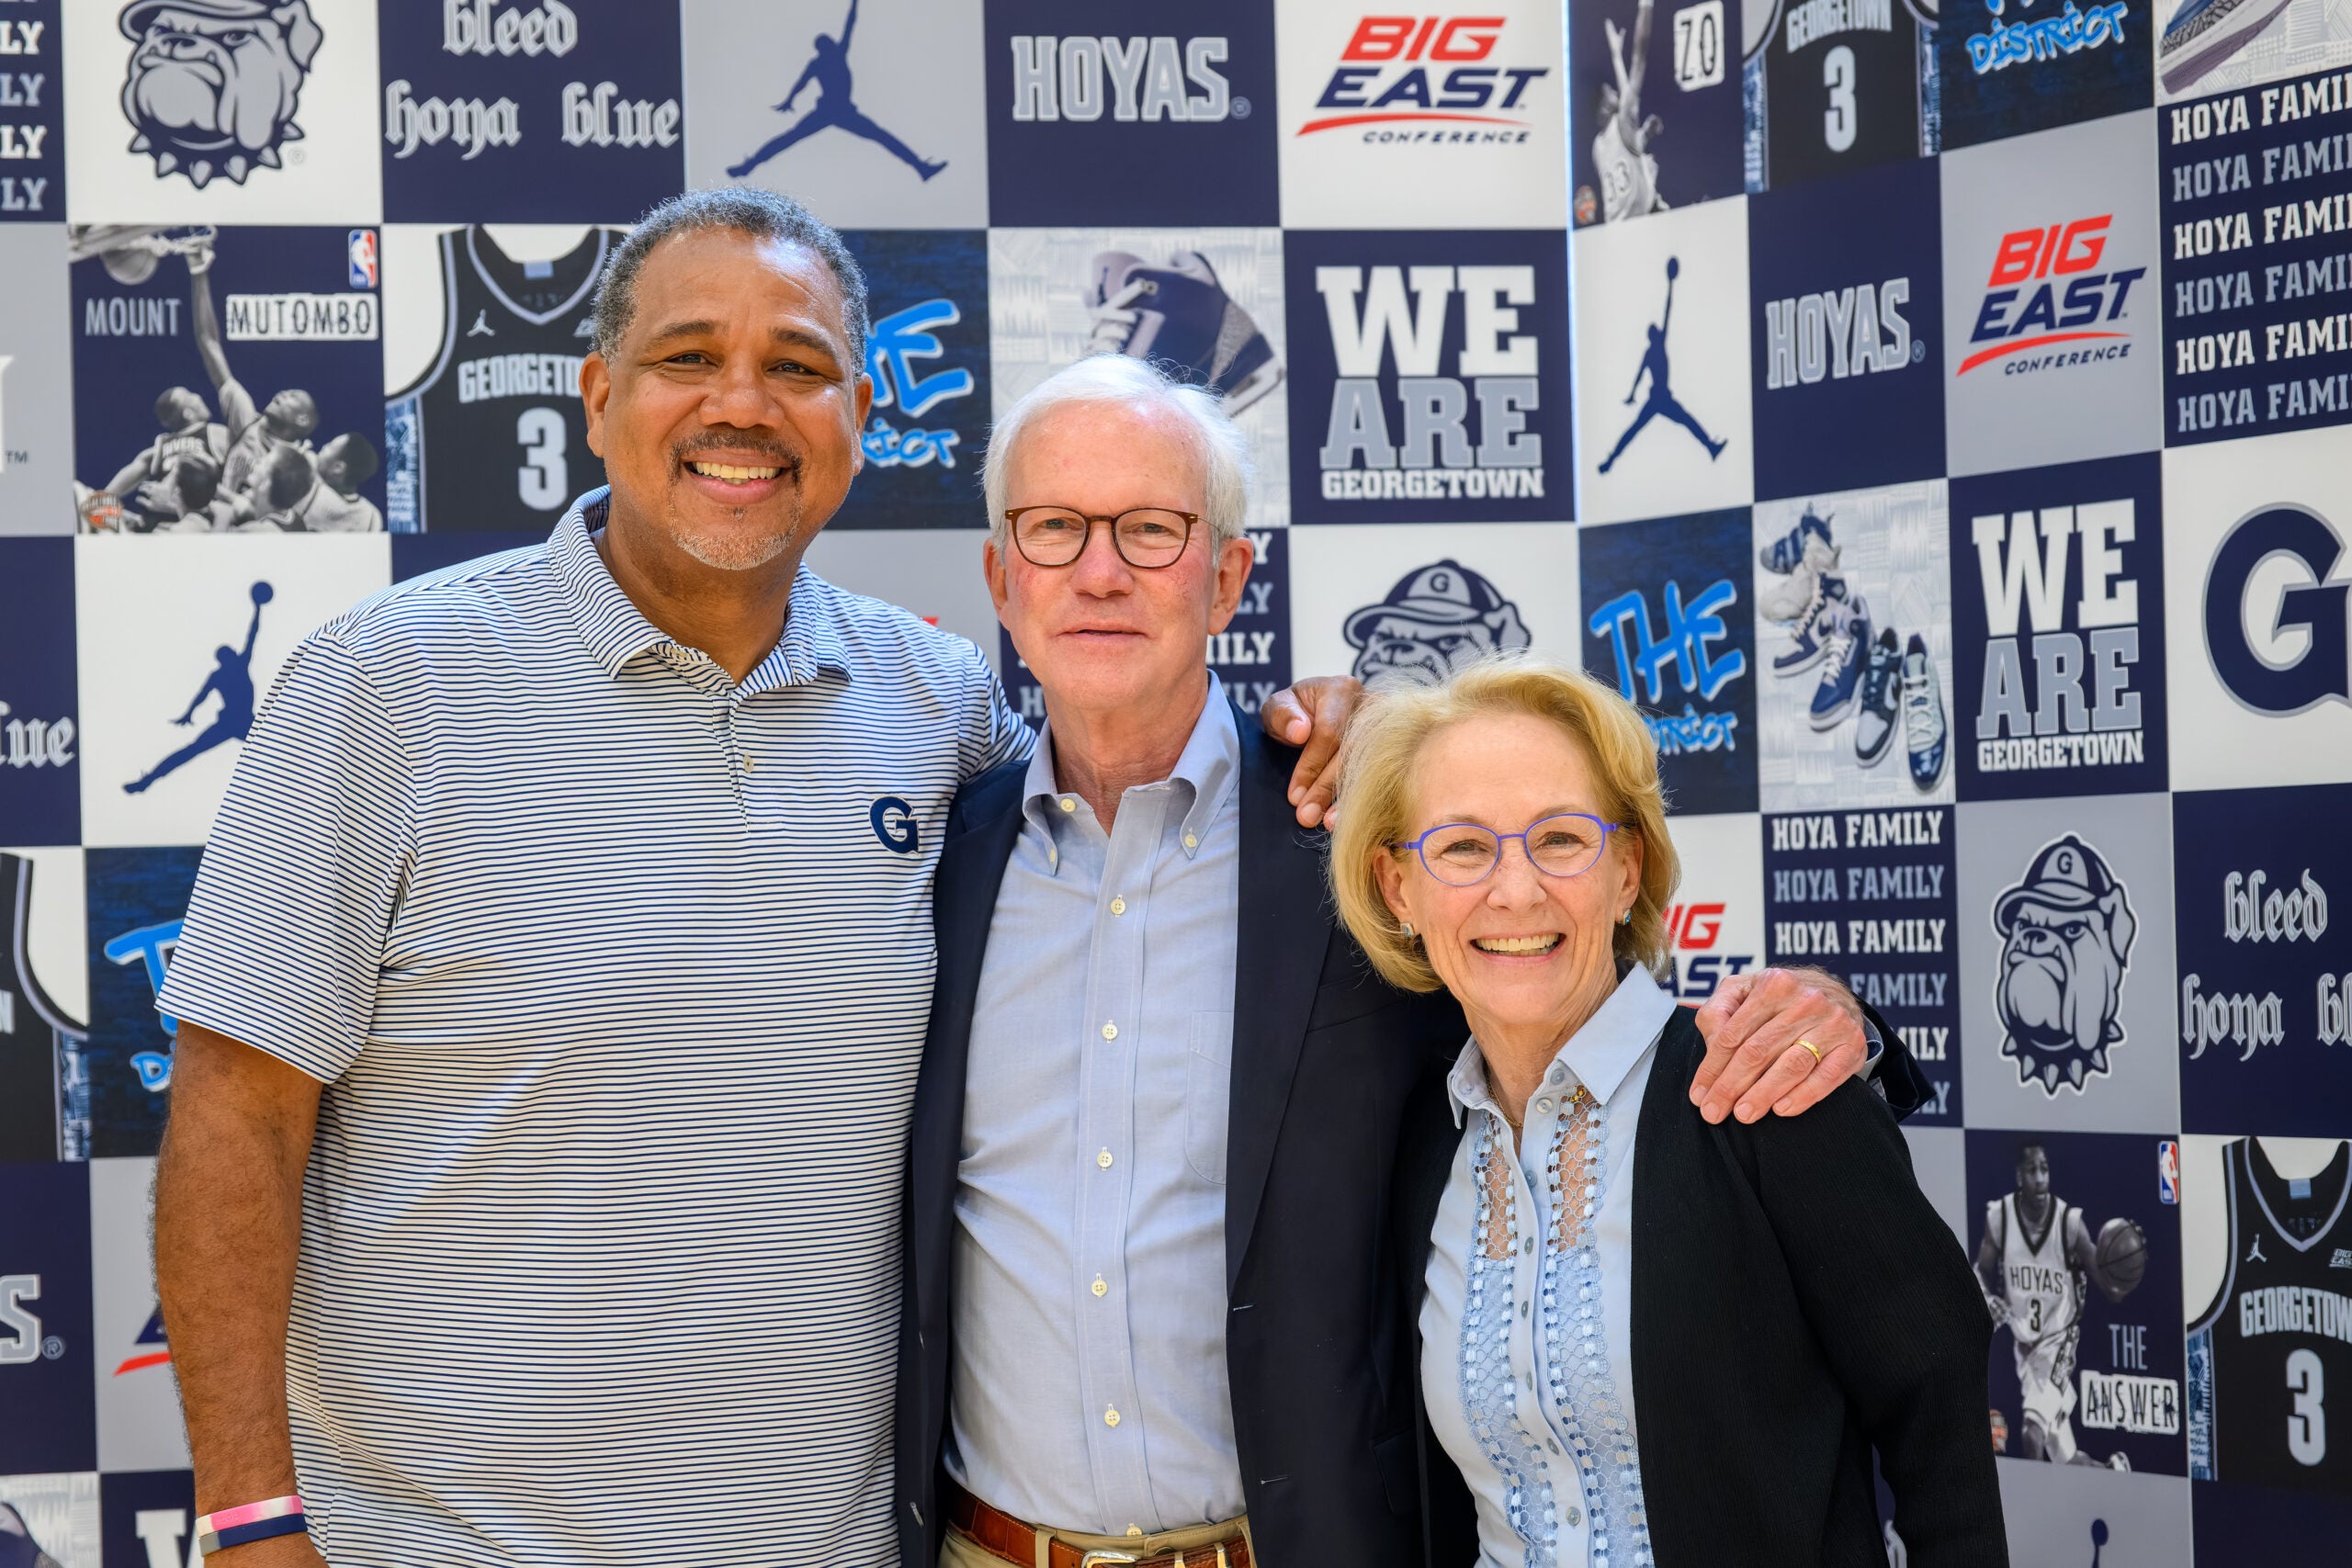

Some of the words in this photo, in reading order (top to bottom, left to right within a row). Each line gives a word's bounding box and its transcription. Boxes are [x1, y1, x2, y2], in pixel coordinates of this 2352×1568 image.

[442, 0, 578, 57] bleed
[1340, 16, 1507, 62] BIG
[1786, 0, 1893, 53] GEORGETOWN
[1012, 36, 1229, 122] HOYAS
[1315, 66, 1551, 108] EAST
[1824, 45, 1857, 152] 3
[2171, 95, 2251, 145] HOYA
[2261, 72, 2352, 126] FAMI
[385, 79, 522, 160] hoya
[561, 81, 681, 148] blue
[1363, 130, 1532, 144] CONFERENCE
[2173, 153, 2252, 202] HOYA
[2262, 132, 2352, 185] FAMI
[1987, 214, 2113, 288] BIG
[2174, 212, 2253, 260] HOYA
[2264, 192, 2352, 244] FAMI
[1970, 266, 2148, 344] EAST
[2176, 271, 2255, 318] HOYA
[2265, 253, 2352, 302] FAMI
[85, 297, 182, 336] MOUNT
[231, 298, 373, 335] MUTOMBO
[1316, 265, 1539, 378] WE
[1766, 276, 1910, 389] HOYAS
[2176, 329, 2256, 375] HOYA
[2266, 313, 2352, 362] FAMI
[458, 354, 588, 404] GEORGETO
[2005, 344, 2132, 376] CONFERENCE
[1319, 378, 1544, 470] ARE
[2177, 388, 2256, 433] HOYA
[2267, 373, 2352, 421] FAMI
[517, 407, 568, 511] 3
[1321, 468, 1545, 501] GEORGETOWN
[1430, 572, 1451, 593] G
[1972, 498, 2139, 637] WE
[2201, 501, 2352, 718] G
[1589, 579, 1746, 704] THE
[1975, 626, 2142, 739] ARE
[1977, 730, 2144, 773] GEORGETOWN
[869, 795, 920, 856] G
[1771, 816, 1838, 852] HOYA
[1845, 810, 1944, 848] FAMILY
[1773, 868, 1839, 903] HOYA
[1847, 865, 1945, 900] FAMILY
[2057, 852, 2073, 874] G
[1662, 903, 1726, 950] IG
[2224, 867, 2328, 943] bleed
[1774, 920, 1841, 955] HOYA
[1848, 919, 1947, 954] FAMILY
[2182, 973, 2286, 1062] hoya
[2009, 1266, 2064, 1294] HOYAS
[2030, 1298, 2042, 1333] 3
[2240, 1286, 2352, 1344] GEORGETOW
[2109, 1323, 2148, 1371] THE
[2086, 1379, 2177, 1428] ANSWER
[2285, 1348, 2327, 1466] 3
